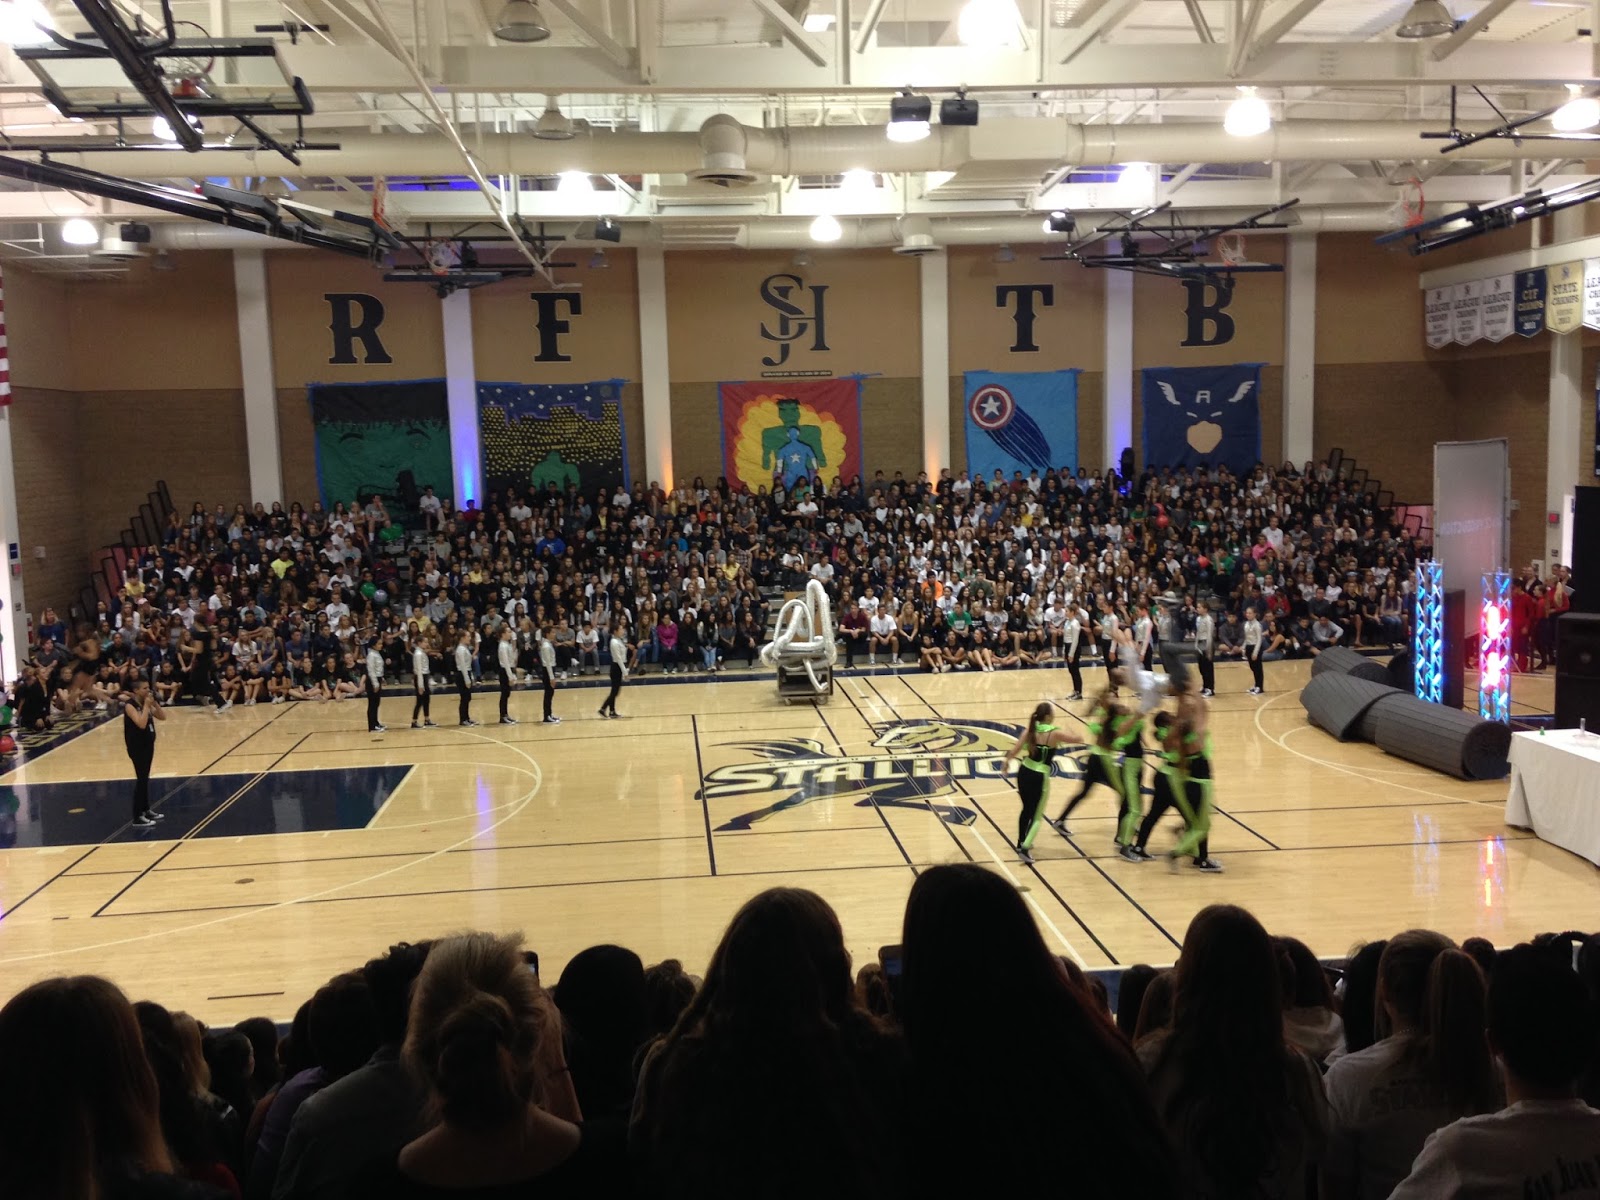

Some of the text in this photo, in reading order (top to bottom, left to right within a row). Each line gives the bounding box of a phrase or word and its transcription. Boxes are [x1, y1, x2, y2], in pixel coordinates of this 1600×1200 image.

[324, 293, 393, 364] R
[530, 292, 582, 362] F
[995, 283, 1055, 353] T
[1180, 279, 1236, 347] B
[696, 748, 1110, 798] STALLIO
